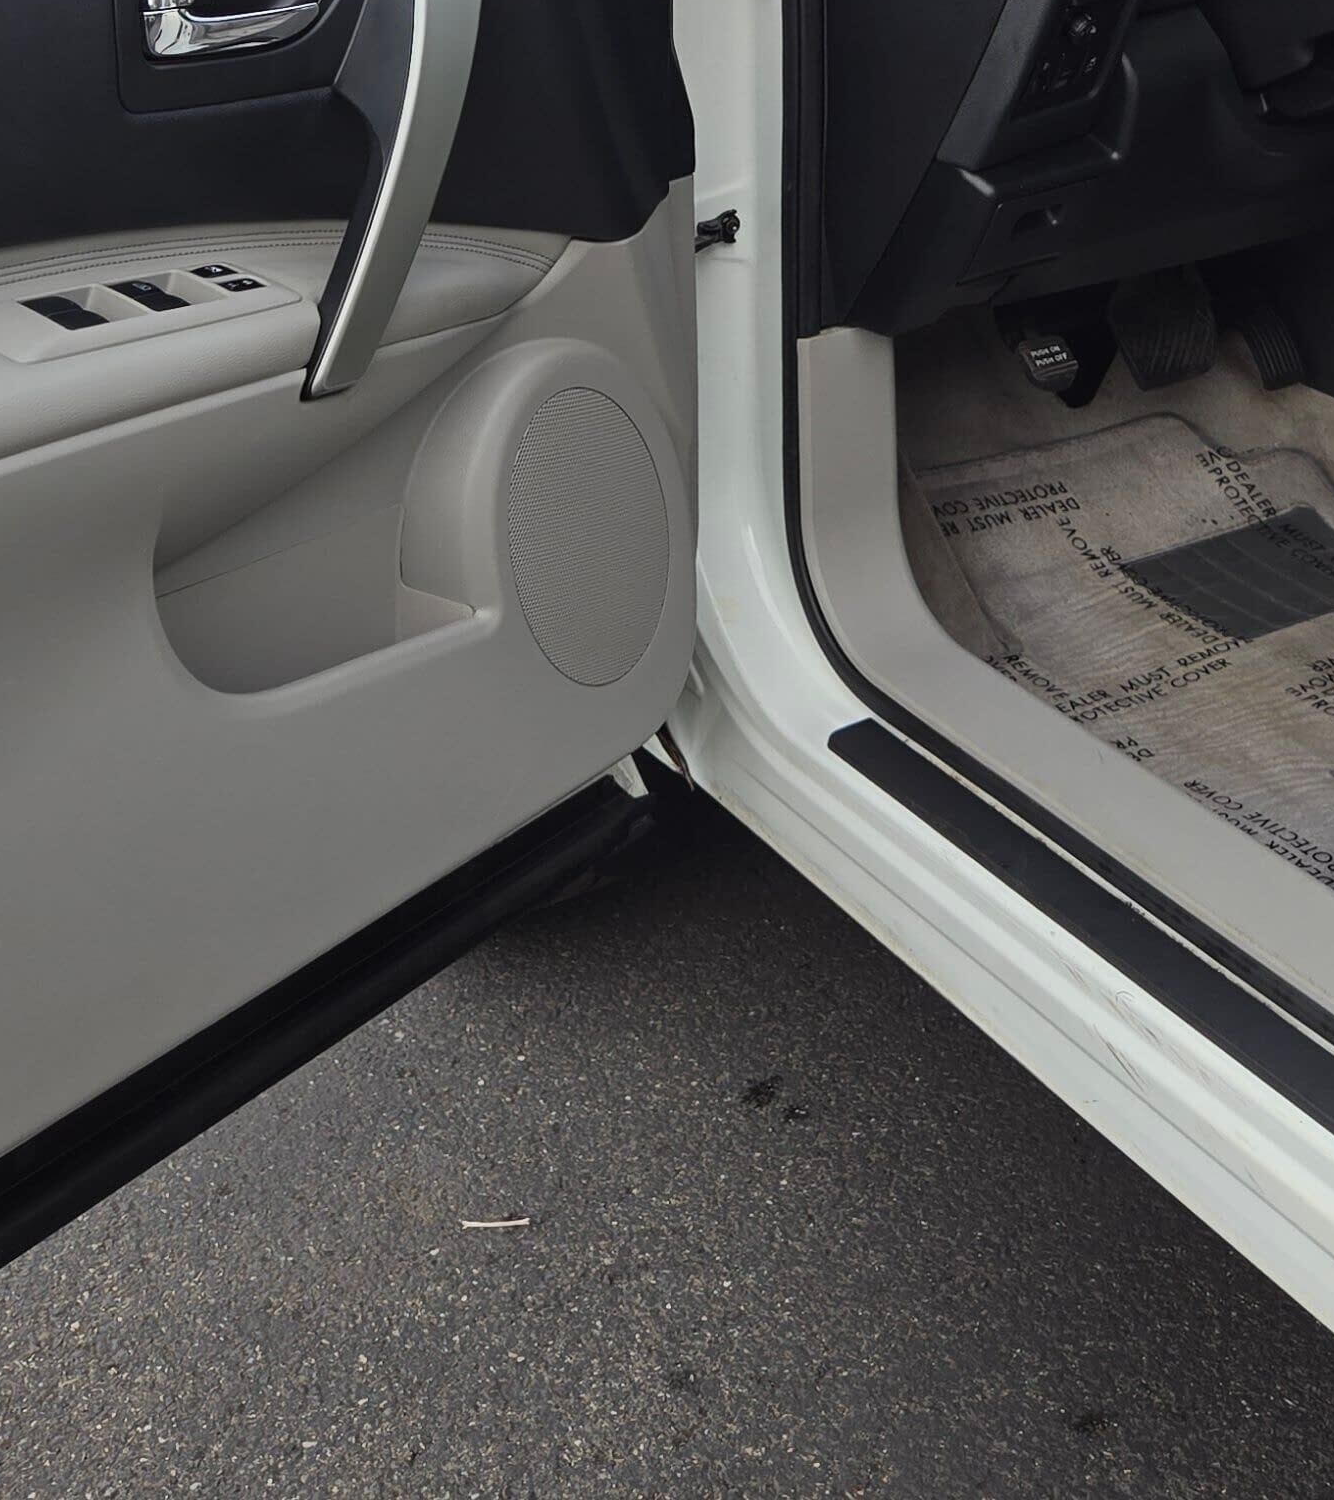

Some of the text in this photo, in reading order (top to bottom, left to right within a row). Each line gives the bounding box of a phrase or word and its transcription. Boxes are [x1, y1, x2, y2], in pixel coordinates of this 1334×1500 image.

[932, 481, 1068, 518] PROTECTIVE COV
[1225, 459, 1277, 518] DEALER
[966, 510, 1012, 532] MUST
[1018, 497, 1080, 521] DEALER
[1057, 516, 1112, 579] REMOVE
[1113, 581, 1157, 610] MUST
[1004, 653, 1070, 700] REMOVE
[1055, 688, 1115, 714] EALER
[1120, 666, 1172, 693] MUST
[1170, 657, 1232, 689] COVER
[1184, 779, 1243, 811] COVER
